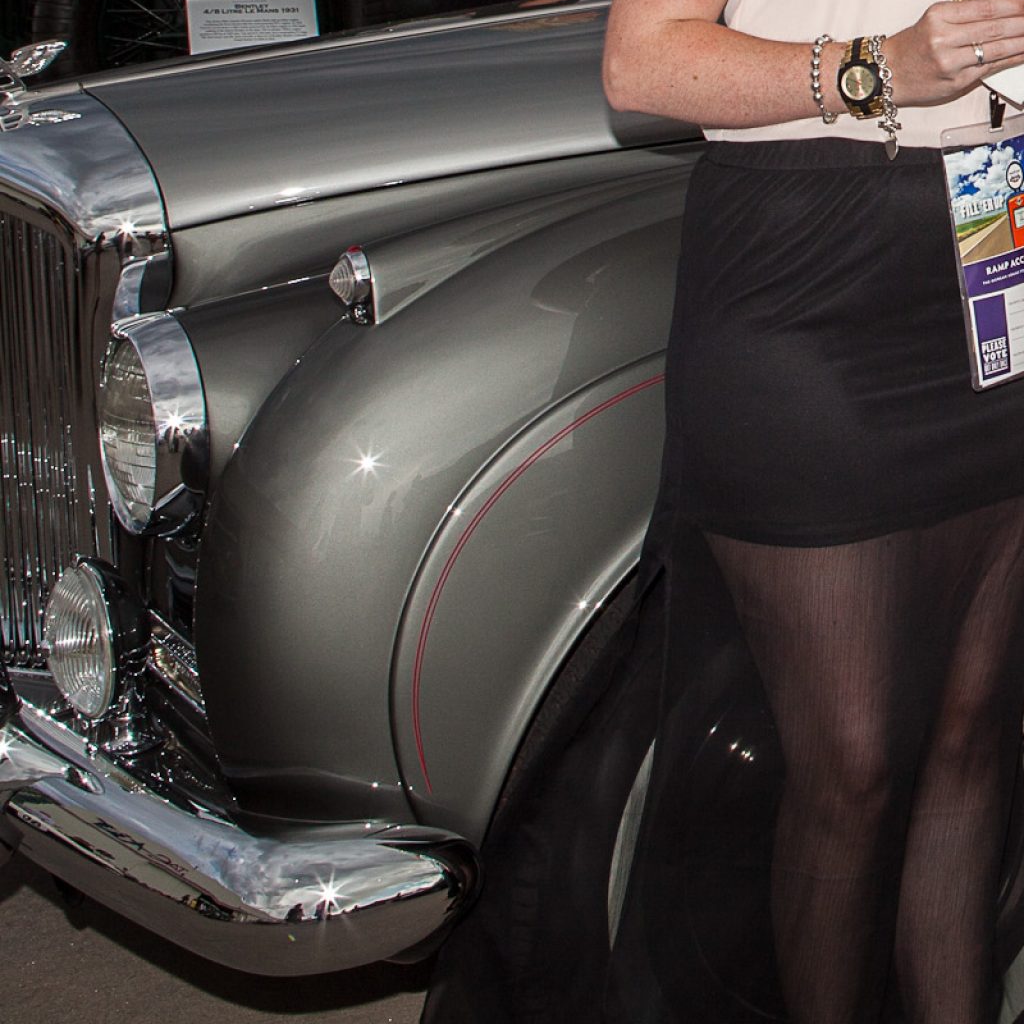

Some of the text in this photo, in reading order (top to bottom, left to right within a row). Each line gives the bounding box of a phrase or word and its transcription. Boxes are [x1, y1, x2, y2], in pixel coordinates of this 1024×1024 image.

[960, 200, 980, 217] FILL
[993, 195, 1005, 209] UP
[986, 262, 1009, 276] RAMP
[981, 338, 1007, 354] PLEASE
[983, 349, 1008, 363] VOTE
